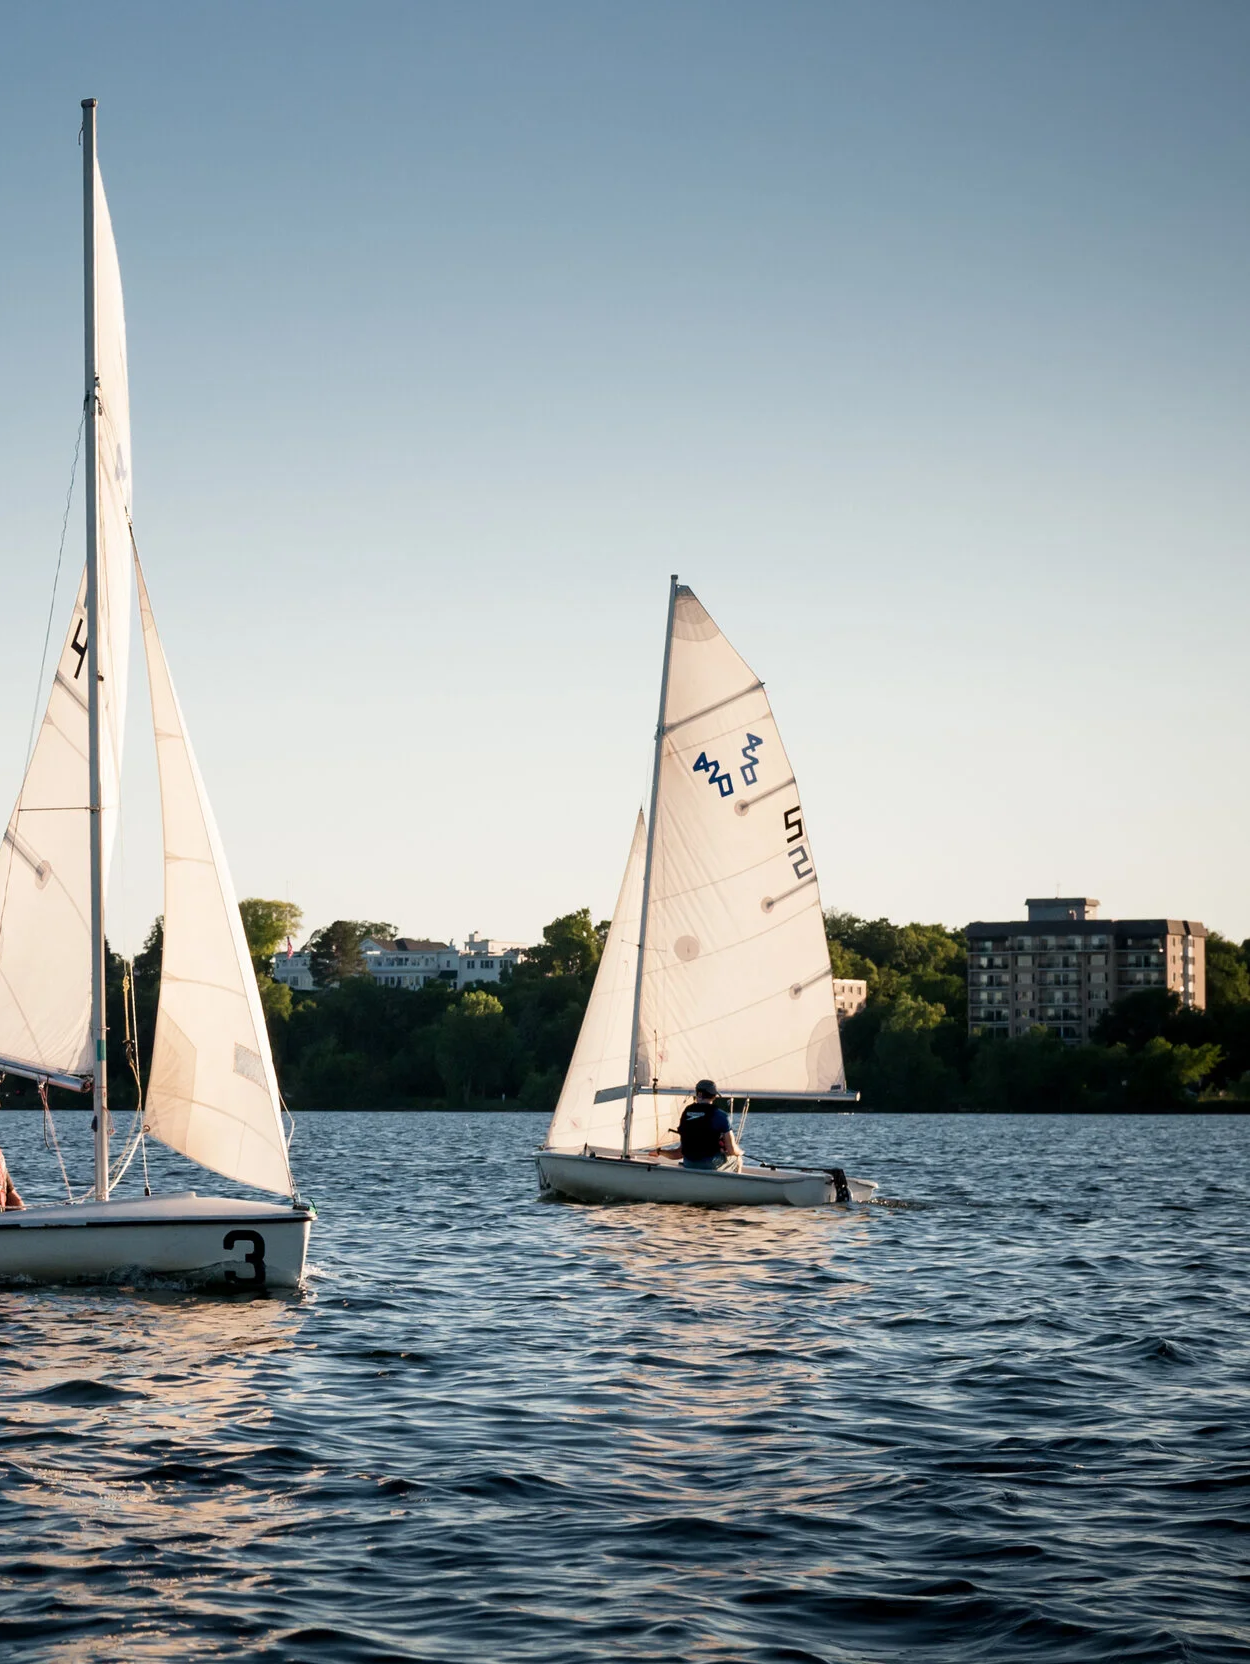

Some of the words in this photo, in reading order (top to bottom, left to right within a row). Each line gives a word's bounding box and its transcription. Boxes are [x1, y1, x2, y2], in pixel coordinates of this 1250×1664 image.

[71, 618, 88, 680] 4
[693, 752, 734, 797] 420
[223, 1229, 266, 1286] 3
